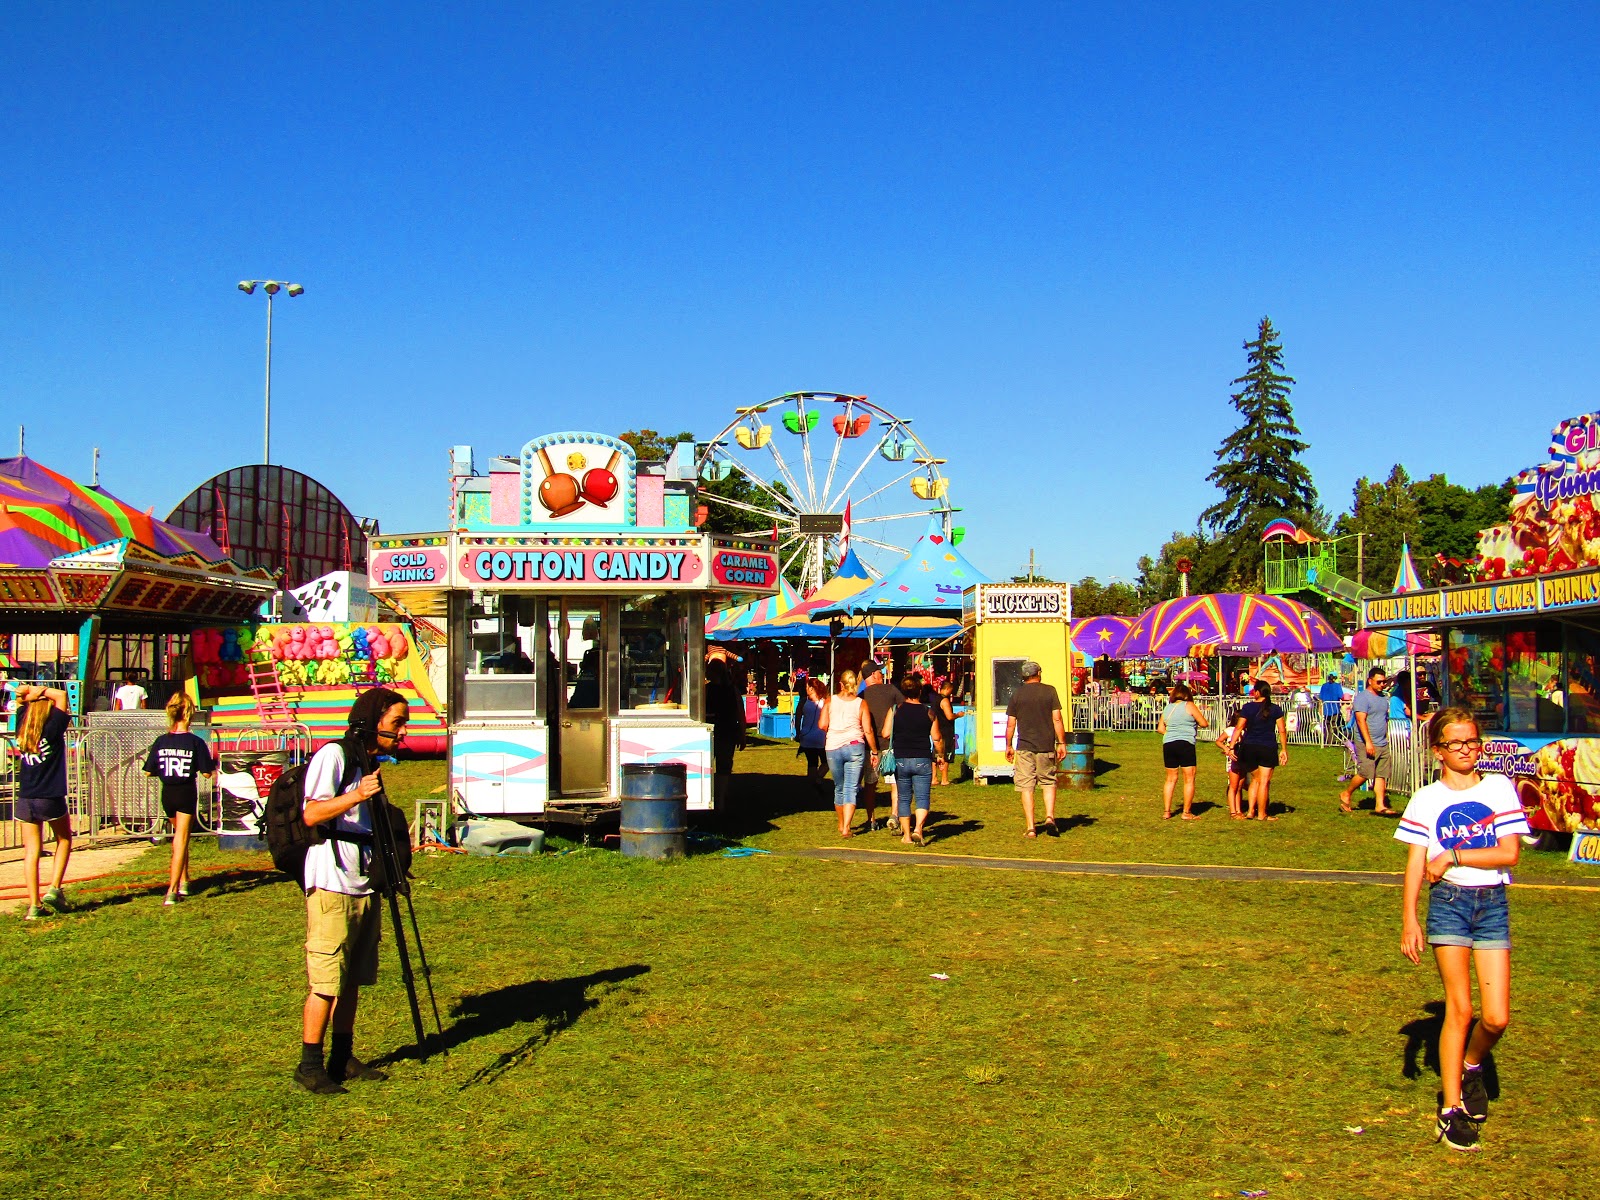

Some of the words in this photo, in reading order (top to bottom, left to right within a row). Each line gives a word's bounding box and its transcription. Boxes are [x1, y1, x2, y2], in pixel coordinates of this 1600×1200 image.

[1564, 422, 1600, 455] GI
[390, 553, 427, 567] COLD
[475, 551, 585, 581] COTTON
[592, 551, 685, 581] CANDY
[720, 553, 769, 571] CARAMEL
[382, 567, 435, 583] DRINKS
[725, 569, 766, 585] CORN
[987, 593, 1060, 613] TICKETS
[1366, 598, 1403, 623] CURLY
[1405, 593, 1440, 621] FRIES
[1445, 587, 1493, 617] FUNNEL
[1494, 581, 1536, 613] CAKES
[1484, 742, 1518, 755] GIANT
[159, 757, 192, 778] FIRE
[1505, 755, 1536, 778] Cakes
[256, 767, 277, 786] TS
[1440, 823, 1495, 840] NASA
